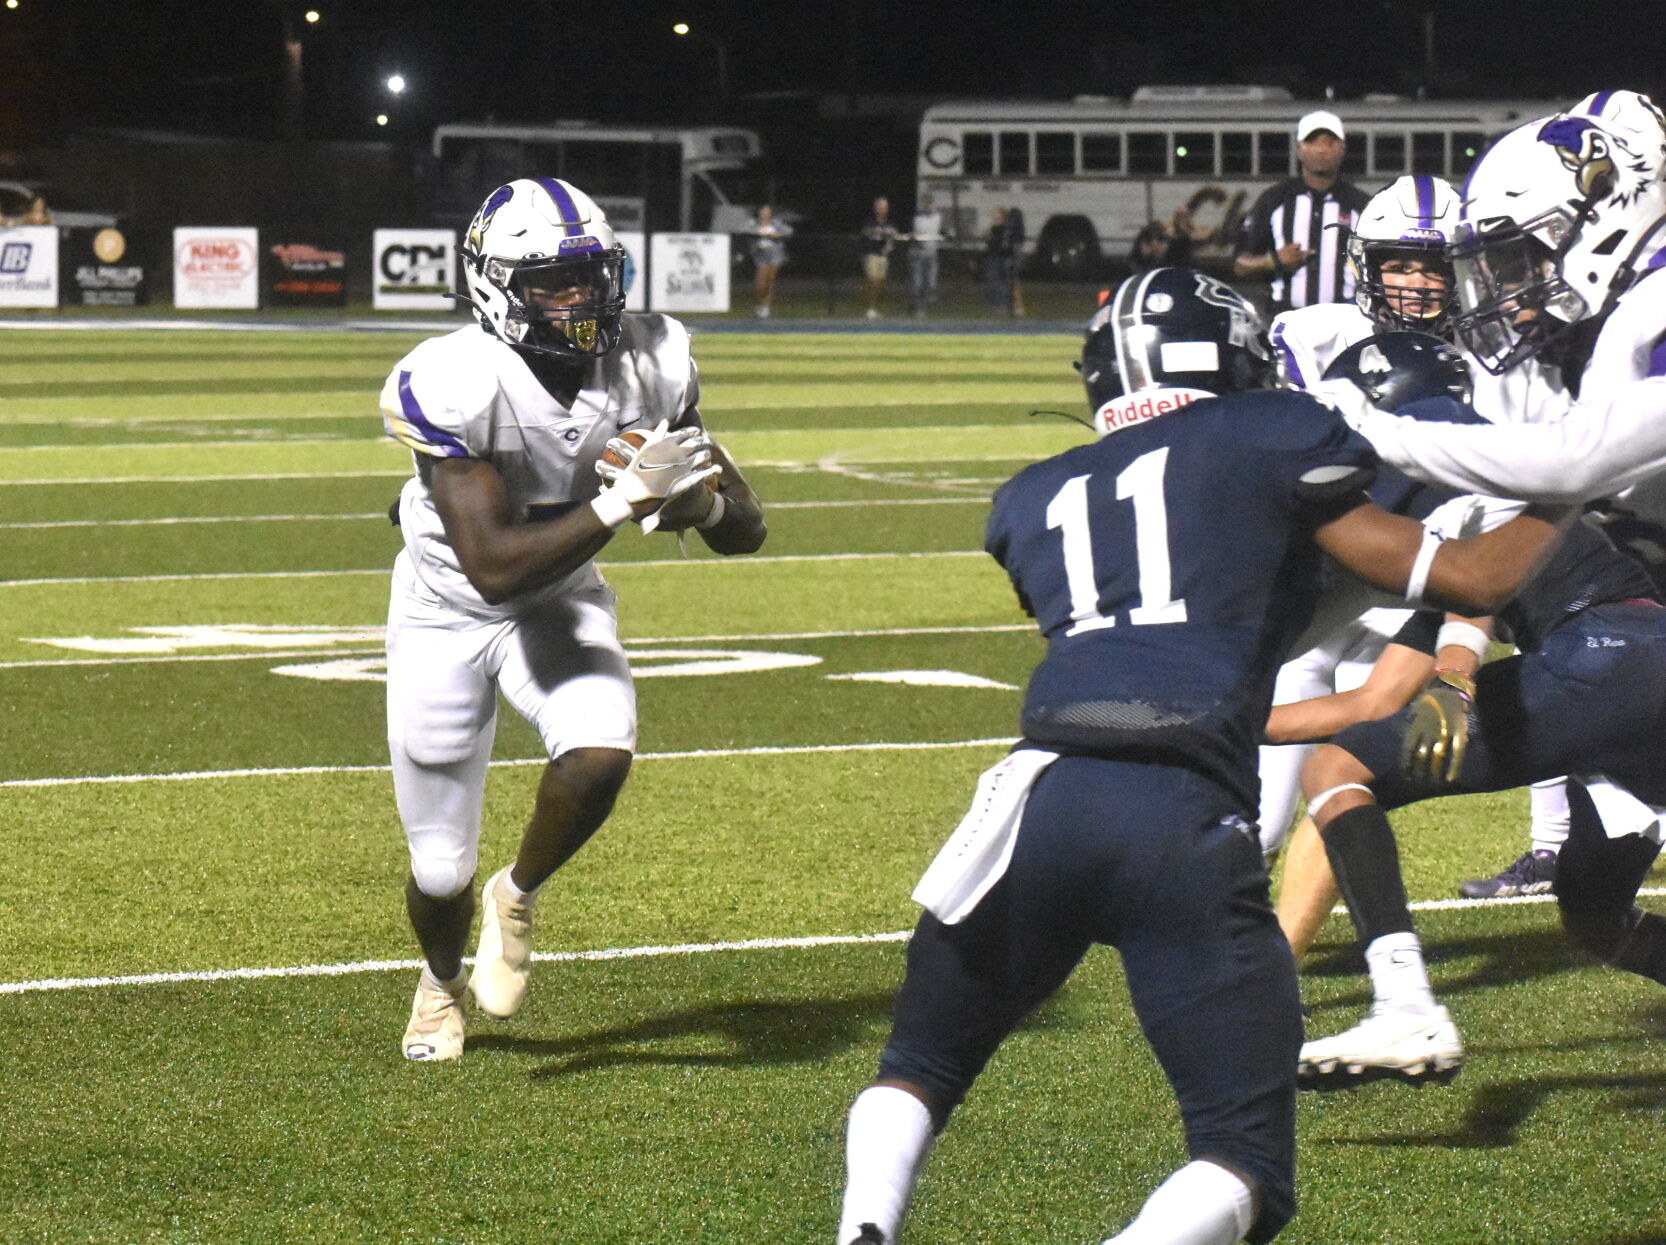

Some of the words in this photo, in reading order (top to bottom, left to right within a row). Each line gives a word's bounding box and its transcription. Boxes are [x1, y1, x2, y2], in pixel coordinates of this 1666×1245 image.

[191, 245, 240, 260] KING
[564, 428, 580, 442] C
[1046, 447, 1188, 637] 11
